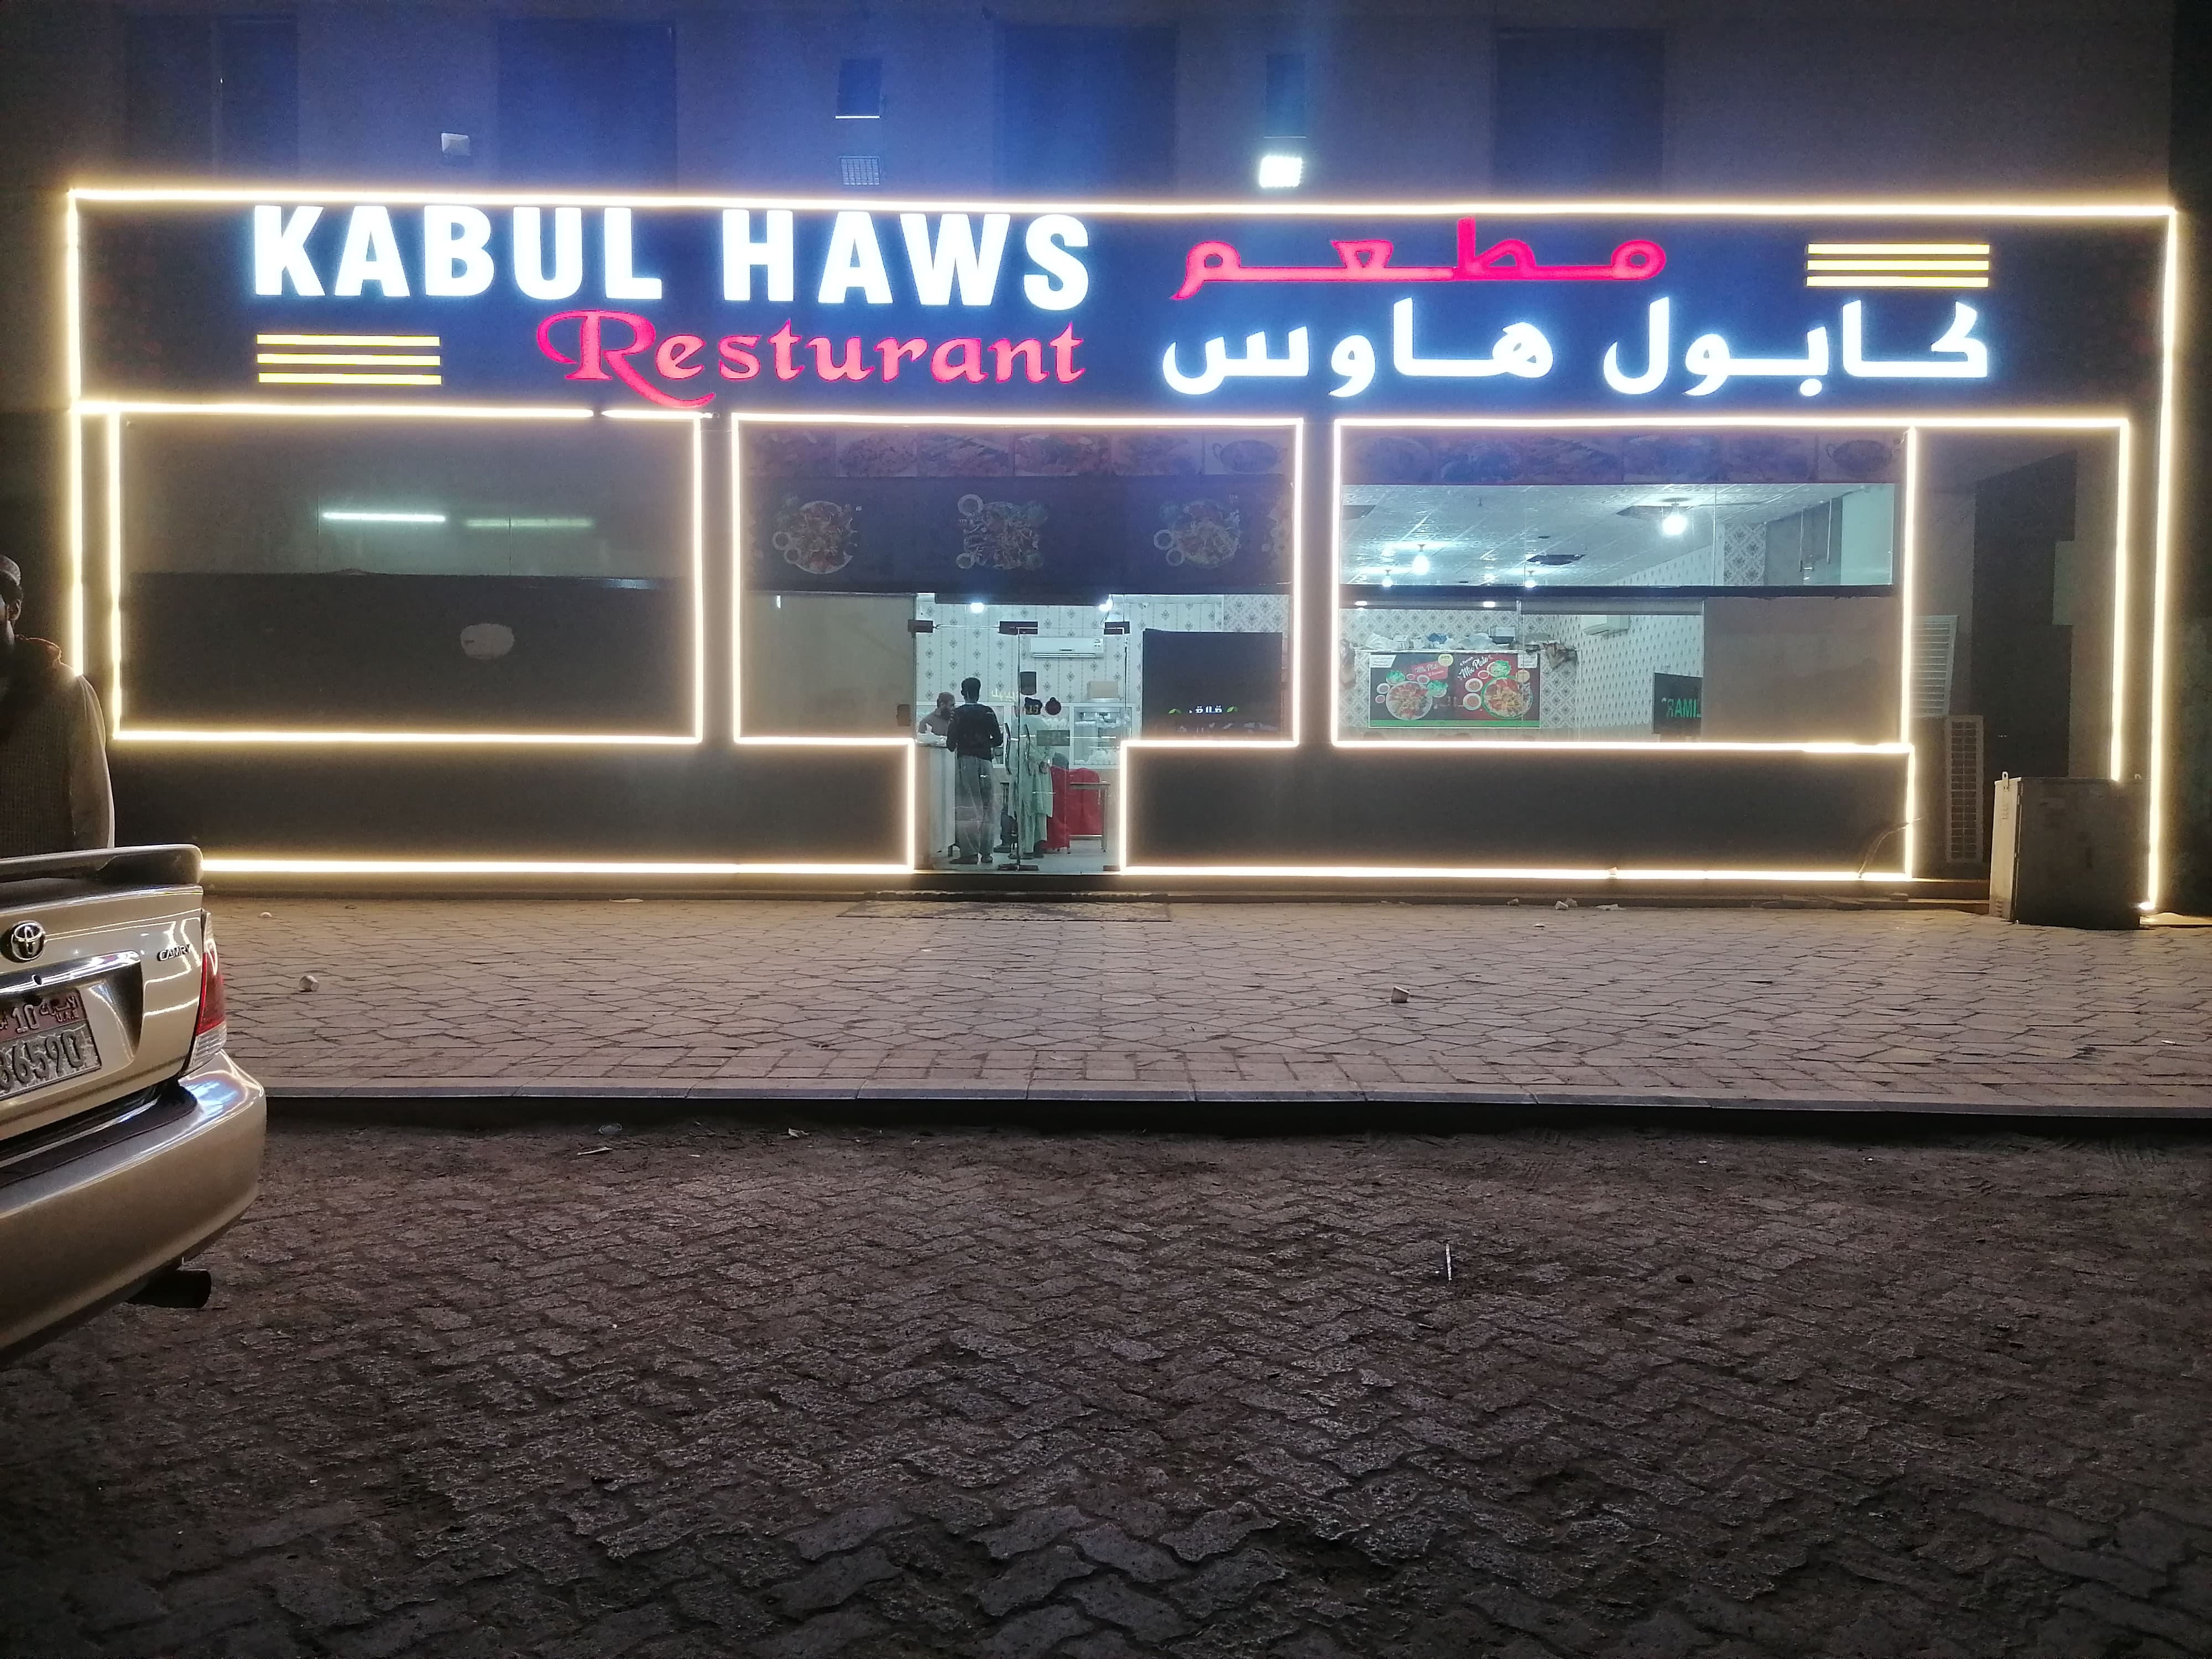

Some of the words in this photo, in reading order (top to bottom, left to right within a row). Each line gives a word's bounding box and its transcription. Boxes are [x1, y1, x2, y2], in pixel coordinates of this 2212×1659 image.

[254, 205, 662, 300] KABUL
[722, 209, 1089, 310] HAWS
[1171, 216, 1666, 300] مطعم
[536, 309, 1085, 408] Resturant
[1162, 297, 1554, 398] هاوس
[1603, 297, 1989, 397] كابول
[156, 943, 191, 961] CAMRY
[12, 1004, 40, 1034] 10
